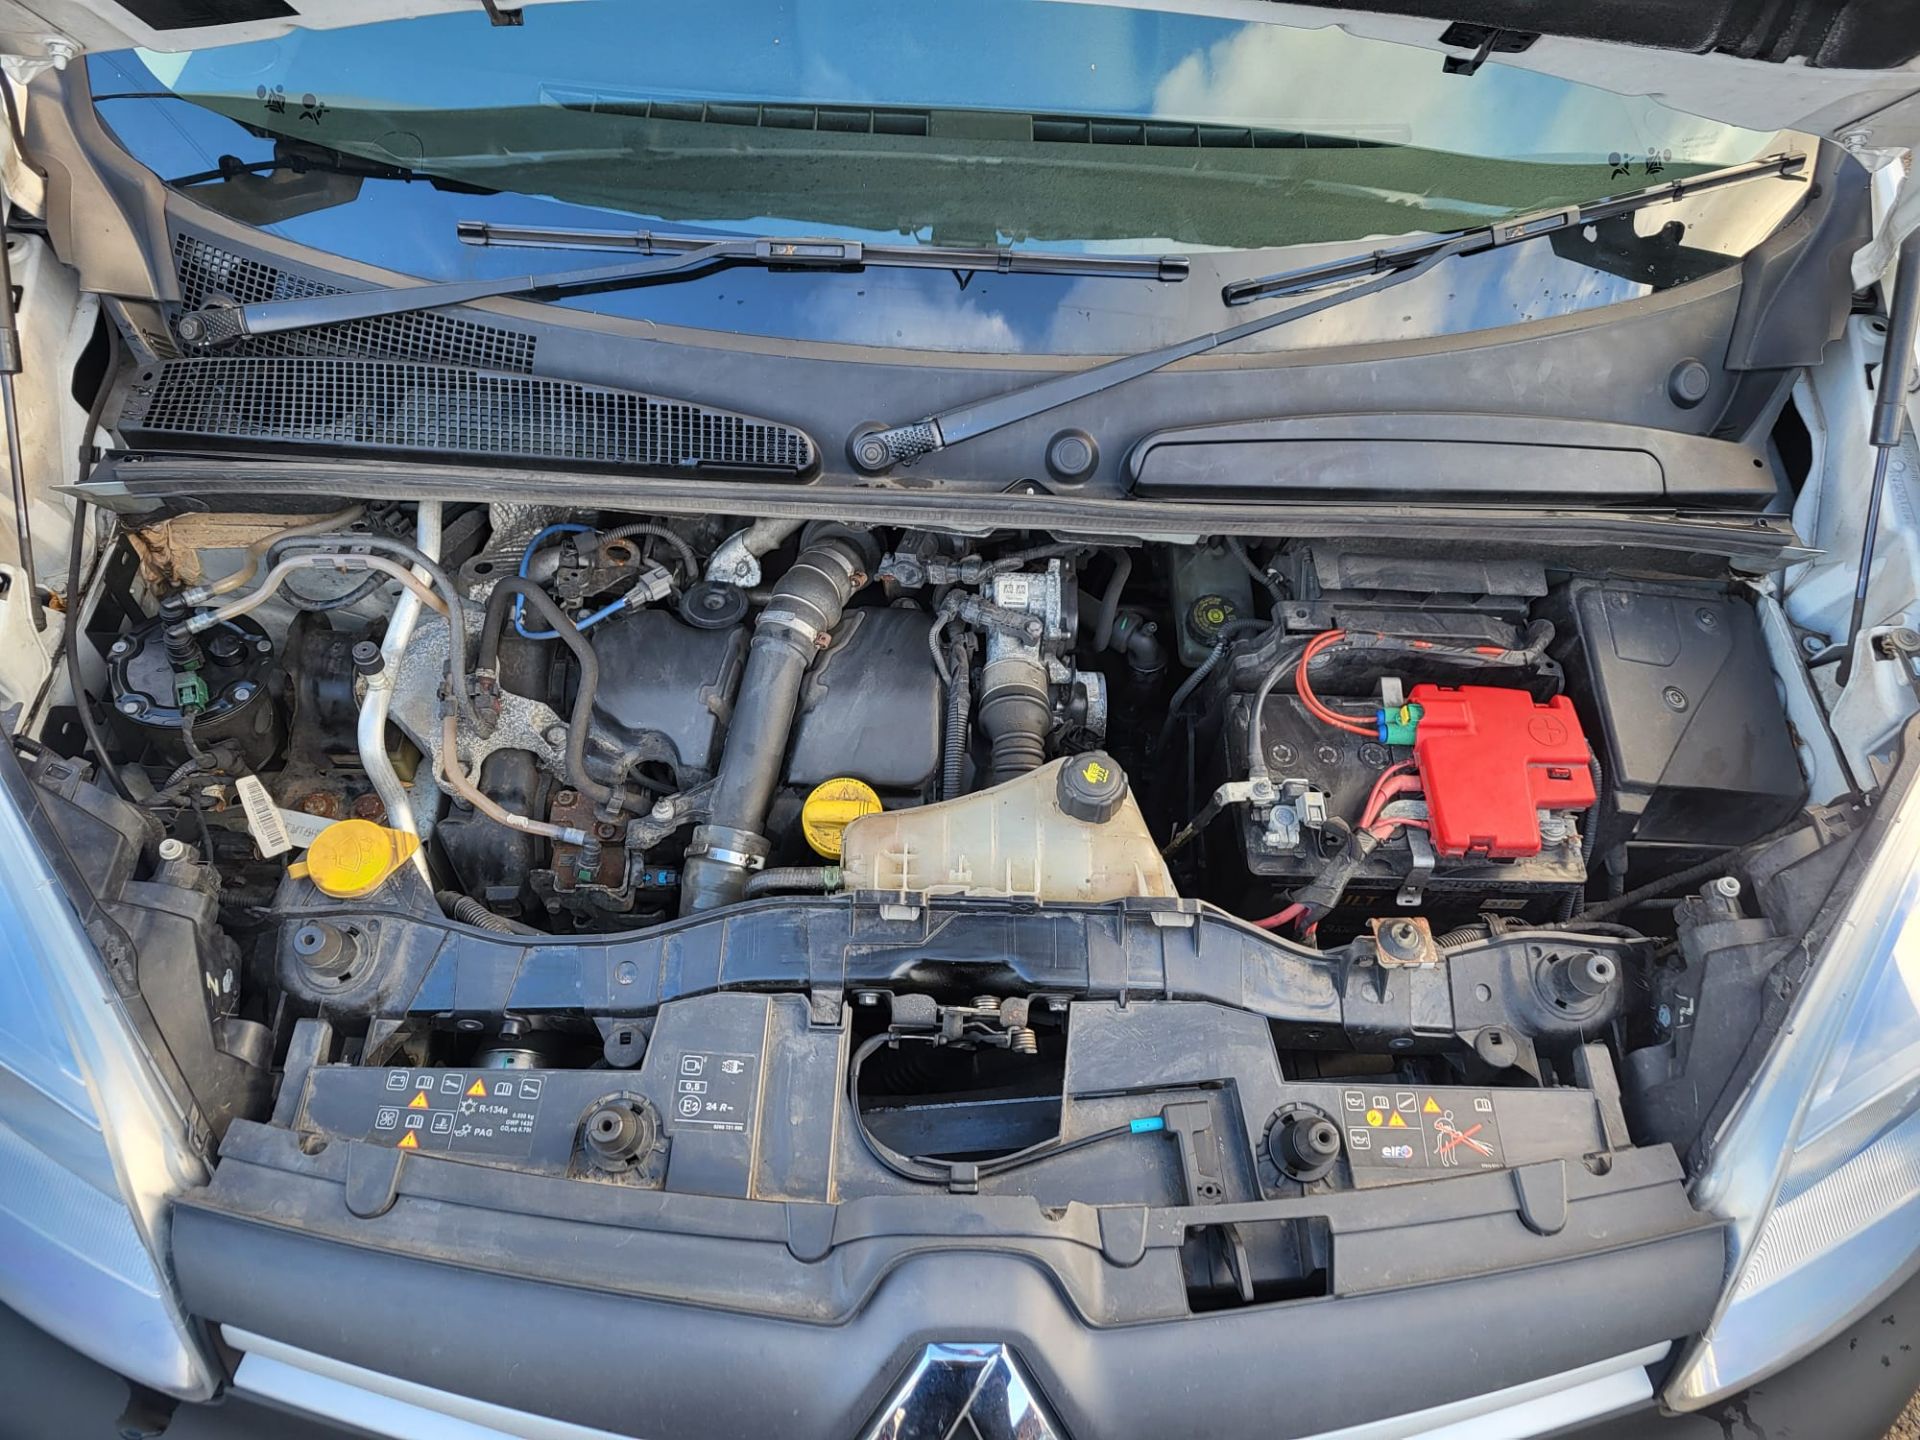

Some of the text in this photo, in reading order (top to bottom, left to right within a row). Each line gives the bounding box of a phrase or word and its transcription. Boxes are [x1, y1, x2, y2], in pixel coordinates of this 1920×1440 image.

[479, 1105, 508, 1115] R-134a
[683, 1100, 698, 1112] E2
[705, 1102, 717, 1111] 24
[474, 1128, 493, 1137] PAG
